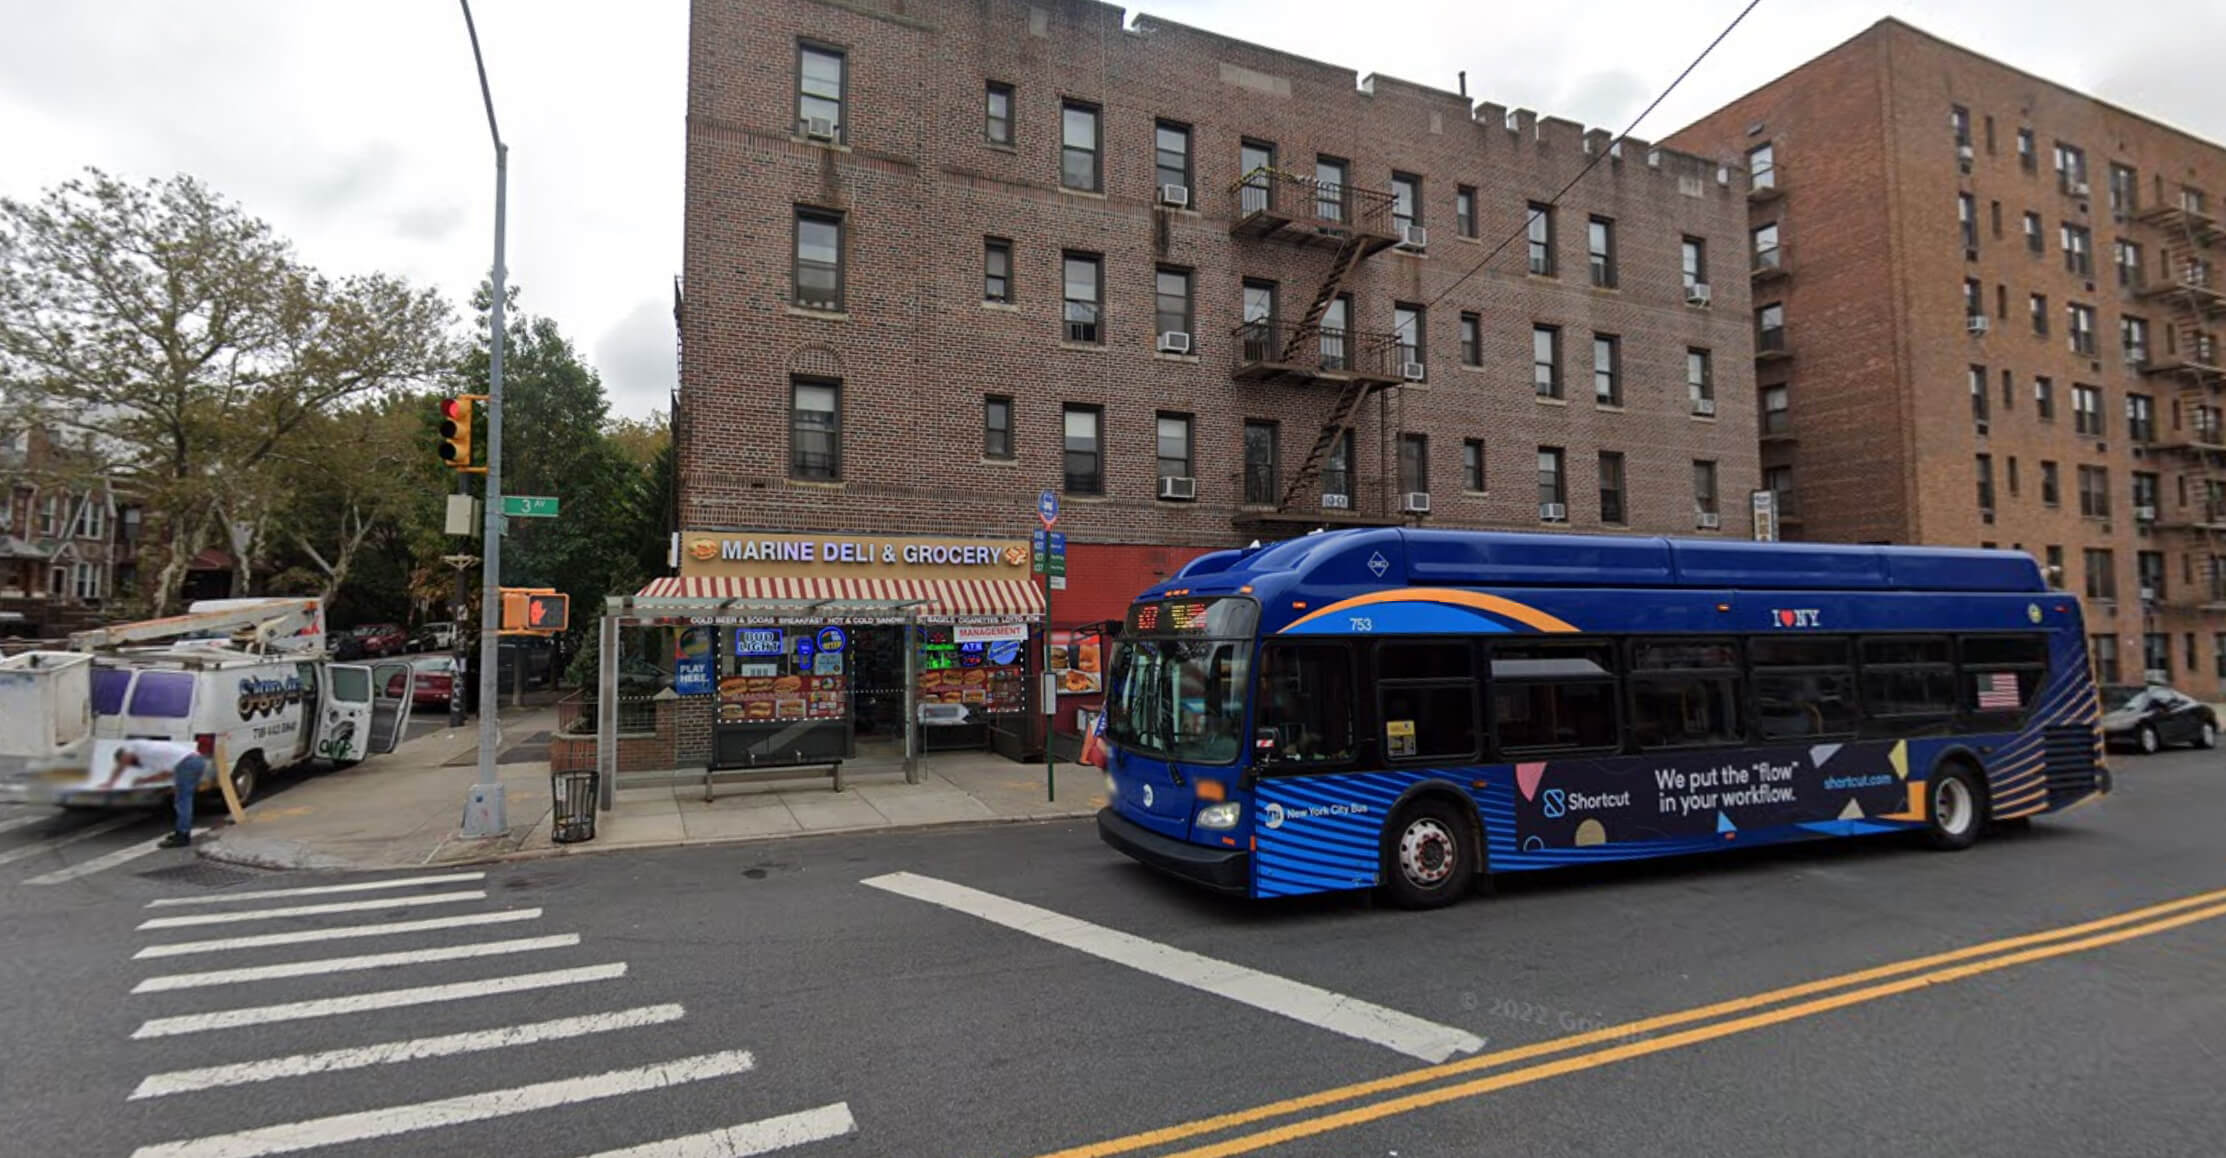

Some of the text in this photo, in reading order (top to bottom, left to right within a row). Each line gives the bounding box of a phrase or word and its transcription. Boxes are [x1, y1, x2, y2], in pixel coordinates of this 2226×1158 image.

[521, 499, 531, 513] 3
[721, 539, 1001, 565] MARINE DELI & GROCERY
[690, 616, 714, 625] COLD
[715, 615, 737, 624] BEER
[747, 616, 776, 625] SODAS
[853, 616, 876, 625] COLD
[1350, 618, 1372, 631] 753
[1772, 609, 1820, 627] I NY
[744, 632, 774, 641] BUD
[959, 626, 1022, 638] MANAGEMENT
[680, 664, 705, 674] PLAY
[680, 674, 709, 683] HERE.
[1655, 768, 1686, 790] We
[1690, 768, 1718, 793] put
[1721, 765, 1749, 785] the
[1824, 774, 1893, 789] shortcut.com
[1568, 791, 1631, 810] Shortcut
[1659, 784, 1797, 817] in your workflow.
[1287, 808, 1308, 819] New
[1308, 806, 1330, 816] York
[1330, 804, 1350, 815] City
[1351, 803, 1368, 813] Bus
